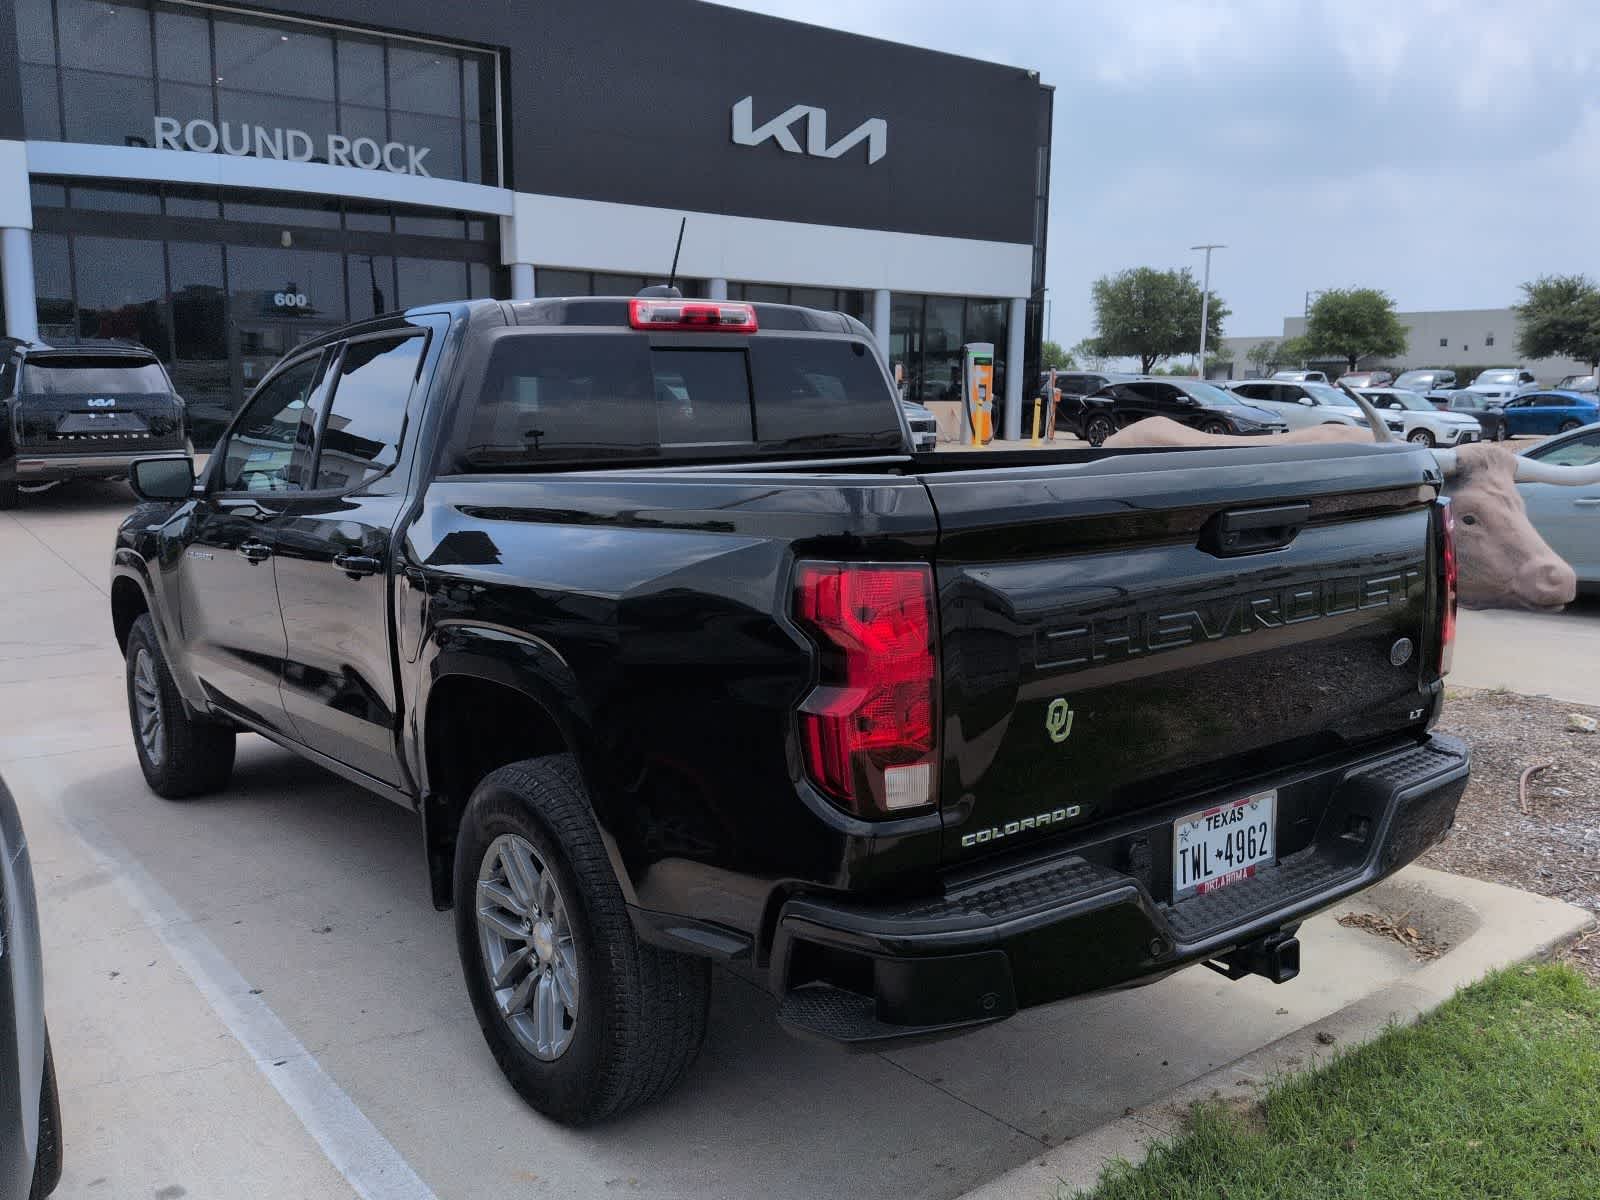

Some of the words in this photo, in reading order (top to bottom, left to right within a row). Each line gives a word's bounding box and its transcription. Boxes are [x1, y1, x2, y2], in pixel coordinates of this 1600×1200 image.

[154, 116, 314, 163] ROUND
[327, 134, 432, 177] ROCK
[273, 292, 308, 307] 600
[1033, 569, 1419, 670] CHEVROLET
[1409, 708, 1425, 720] LT
[961, 805, 1081, 847] COLORADO
[1205, 806, 1244, 832] TEXAS
[1224, 821, 1268, 868] 4962
